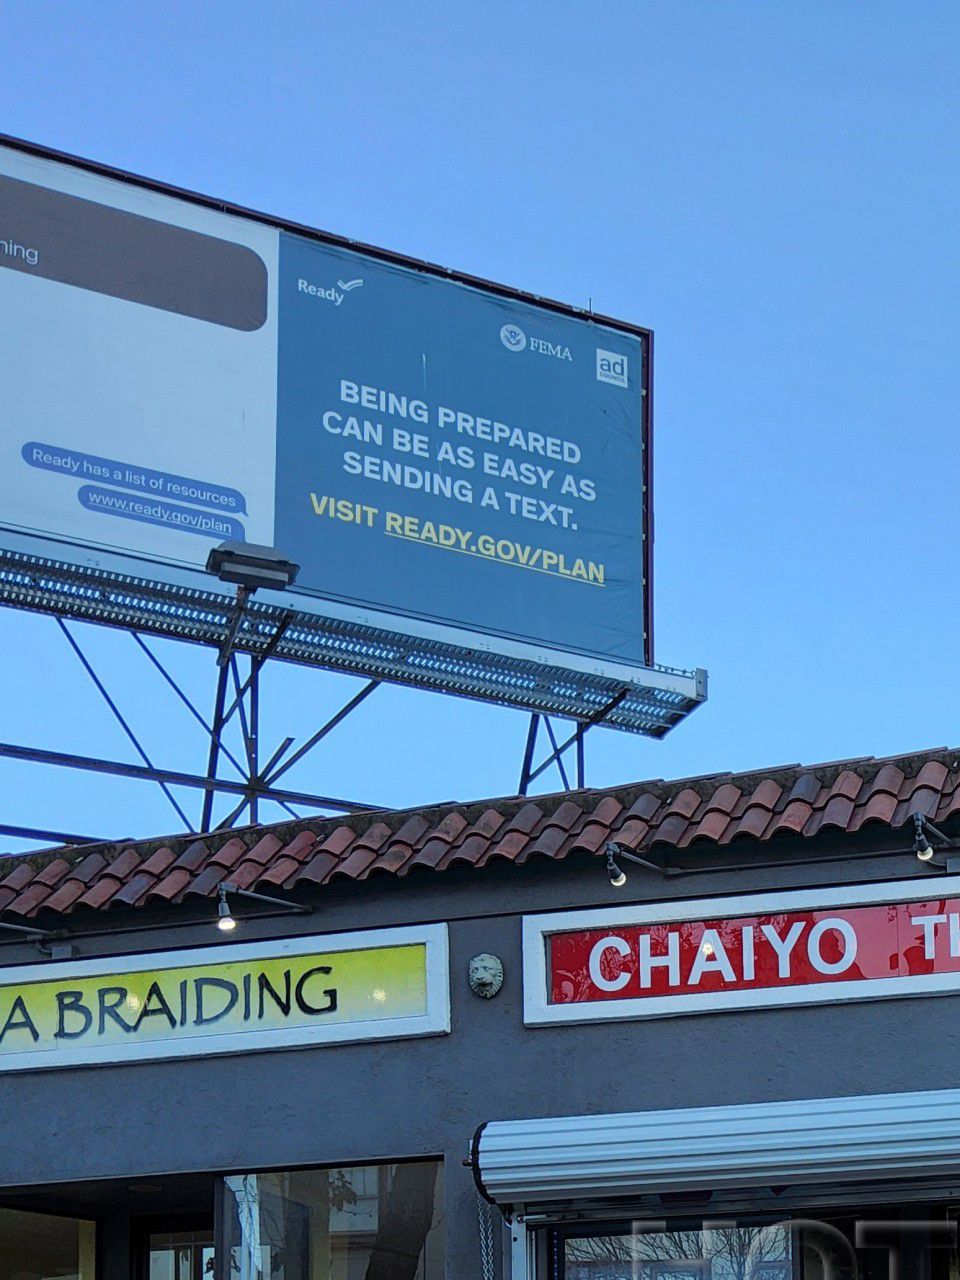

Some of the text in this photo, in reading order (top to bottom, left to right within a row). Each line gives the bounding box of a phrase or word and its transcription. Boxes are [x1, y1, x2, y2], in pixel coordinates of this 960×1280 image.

[298, 279, 344, 305] Ready
[529, 337, 573, 361] FEMA
[600, 358, 624, 376] ad
[322, 411, 597, 502] CAN BE AS EASY AS
[340, 379, 581, 464] BEING PREPARED
[32, 448, 237, 508] Ready has a list of resources
[89, 491, 233, 535] www.ready.gov/plan
[342, 451, 578, 530] SENDING A TEXT.
[310, 493, 605, 585] VISIT READY.GOV/PLAN
[588, 916, 857, 994] CHAIYO
[54, 965, 338, 1040] BRAIDING
